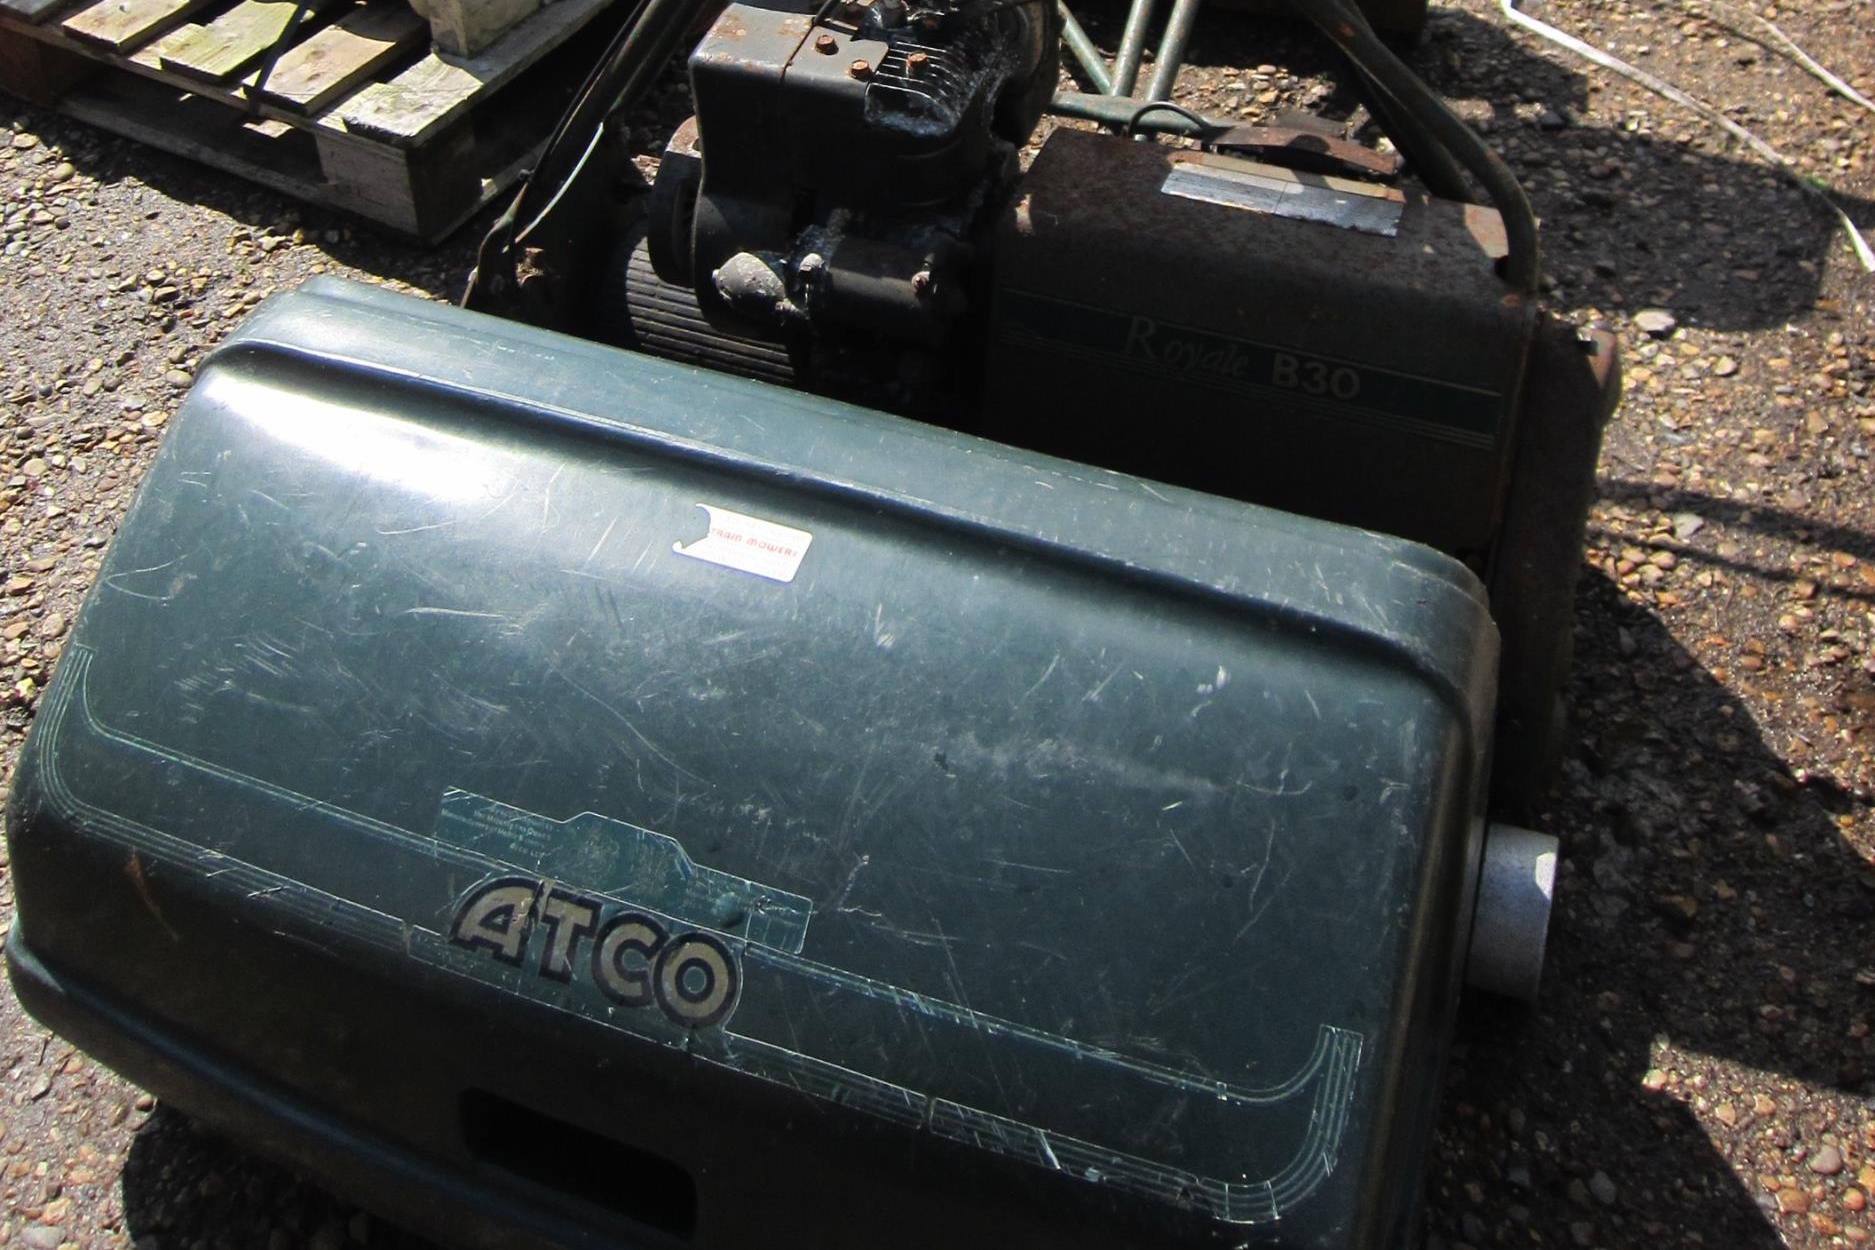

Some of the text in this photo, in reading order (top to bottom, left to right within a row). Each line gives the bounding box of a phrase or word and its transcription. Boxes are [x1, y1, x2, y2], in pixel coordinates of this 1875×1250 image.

[1126, 316, 1361, 401] Royale B30
[450, 875, 740, 1028] ATCO
